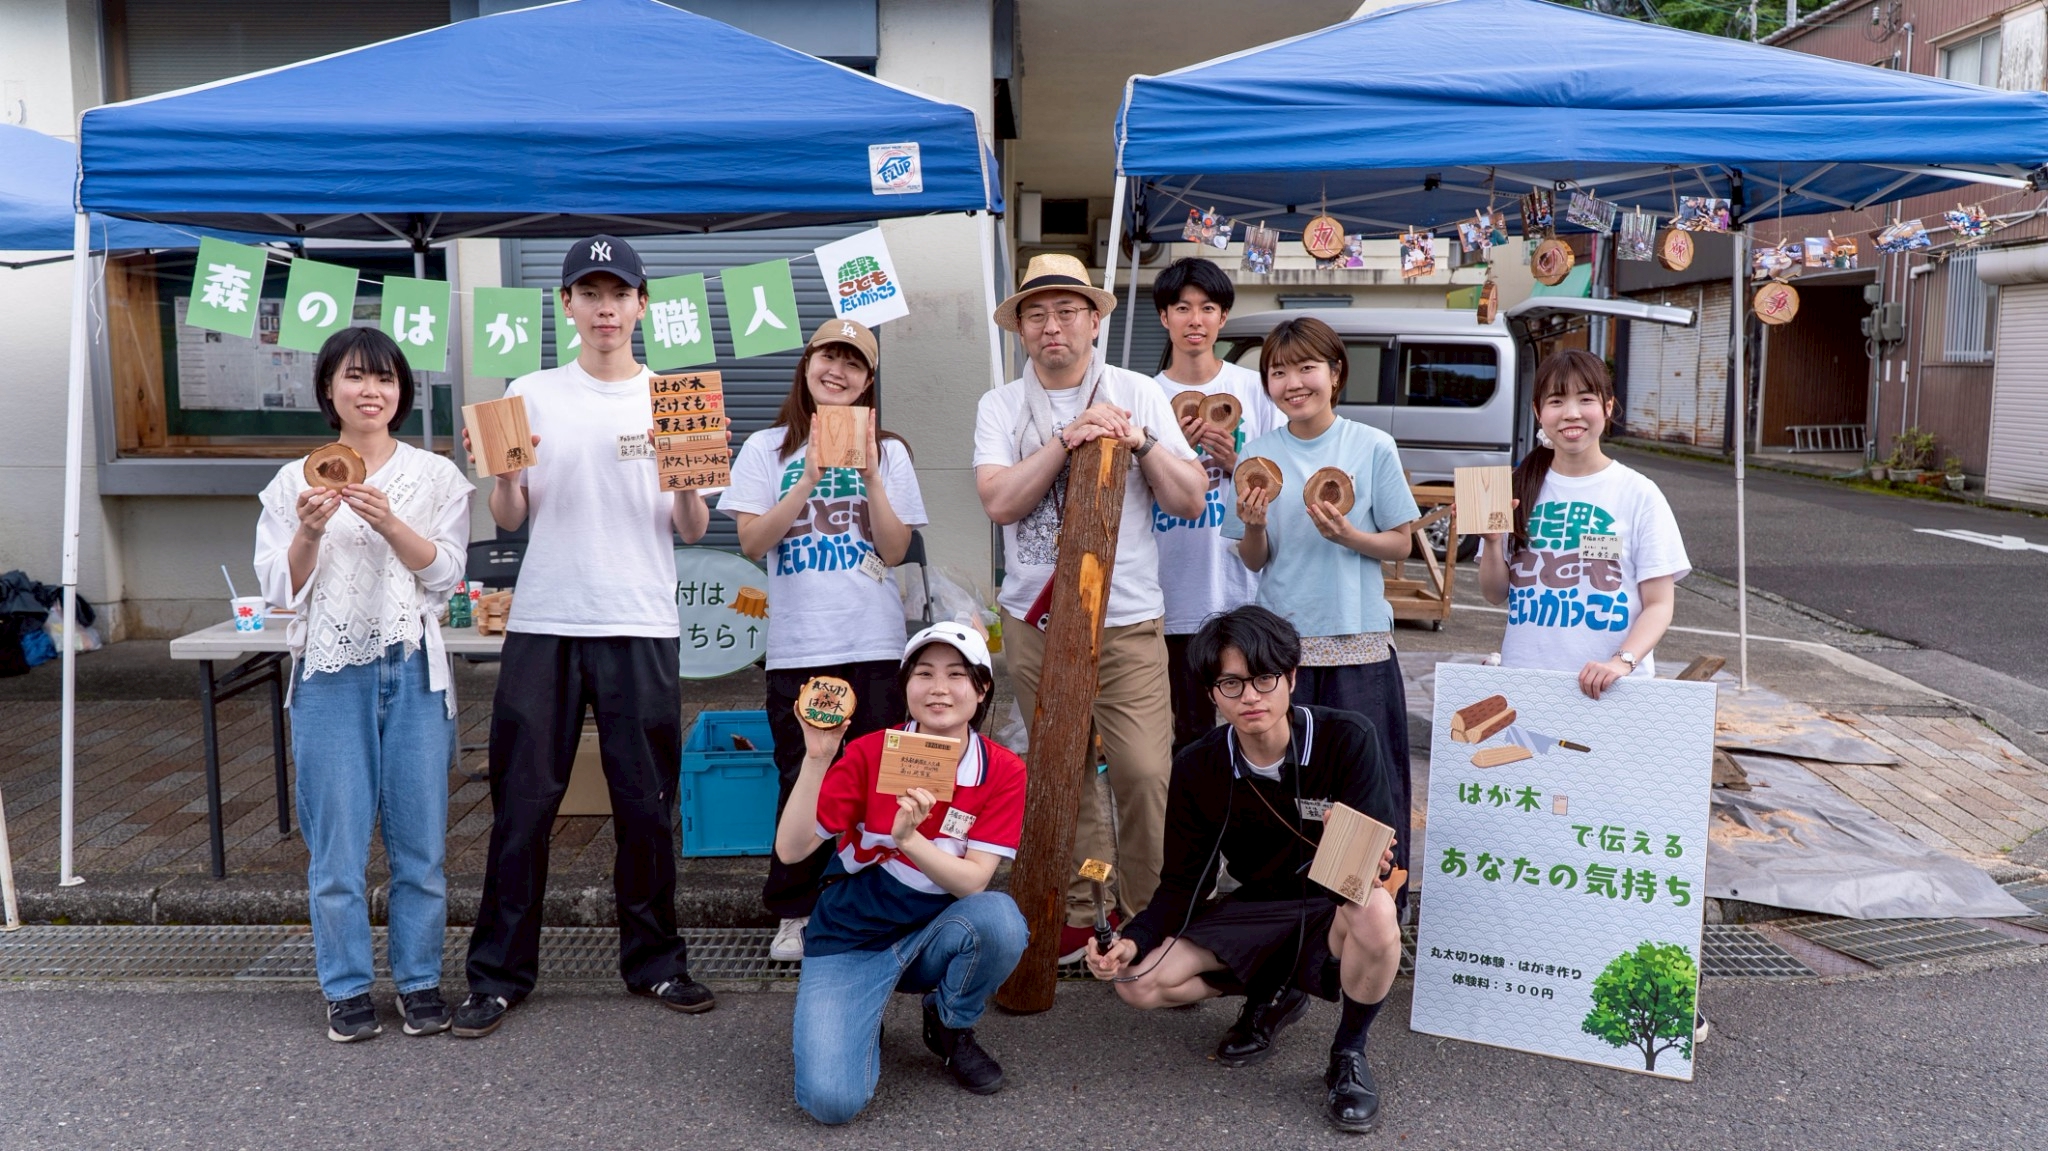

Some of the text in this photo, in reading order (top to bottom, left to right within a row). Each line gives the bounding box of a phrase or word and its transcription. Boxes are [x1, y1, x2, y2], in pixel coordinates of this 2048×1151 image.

[1311, 221, 1333, 254] 丸
[837, 255, 881, 283] 熊野
[838, 271, 888, 297] こども
[839, 281, 896, 313] だいがっこう
[841, 322, 857, 338] LA
[654, 376, 706, 394] はが木
[653, 396, 706, 414] だけでも
[662, 454, 728, 469] ポストに入れて
[676, 580, 725, 606] 付は
[688, 623, 736, 649] ちら
[805, 708, 844, 725] 300円
[808, 698, 845, 713] はが木
[1458, 783, 1542, 813] はが木
[1571, 824, 1683, 859] で伝える
[1440, 847, 1691, 907] あなたの気持ち
[1430, 946, 1582, 980] 丸太切り体験・はがき作り
